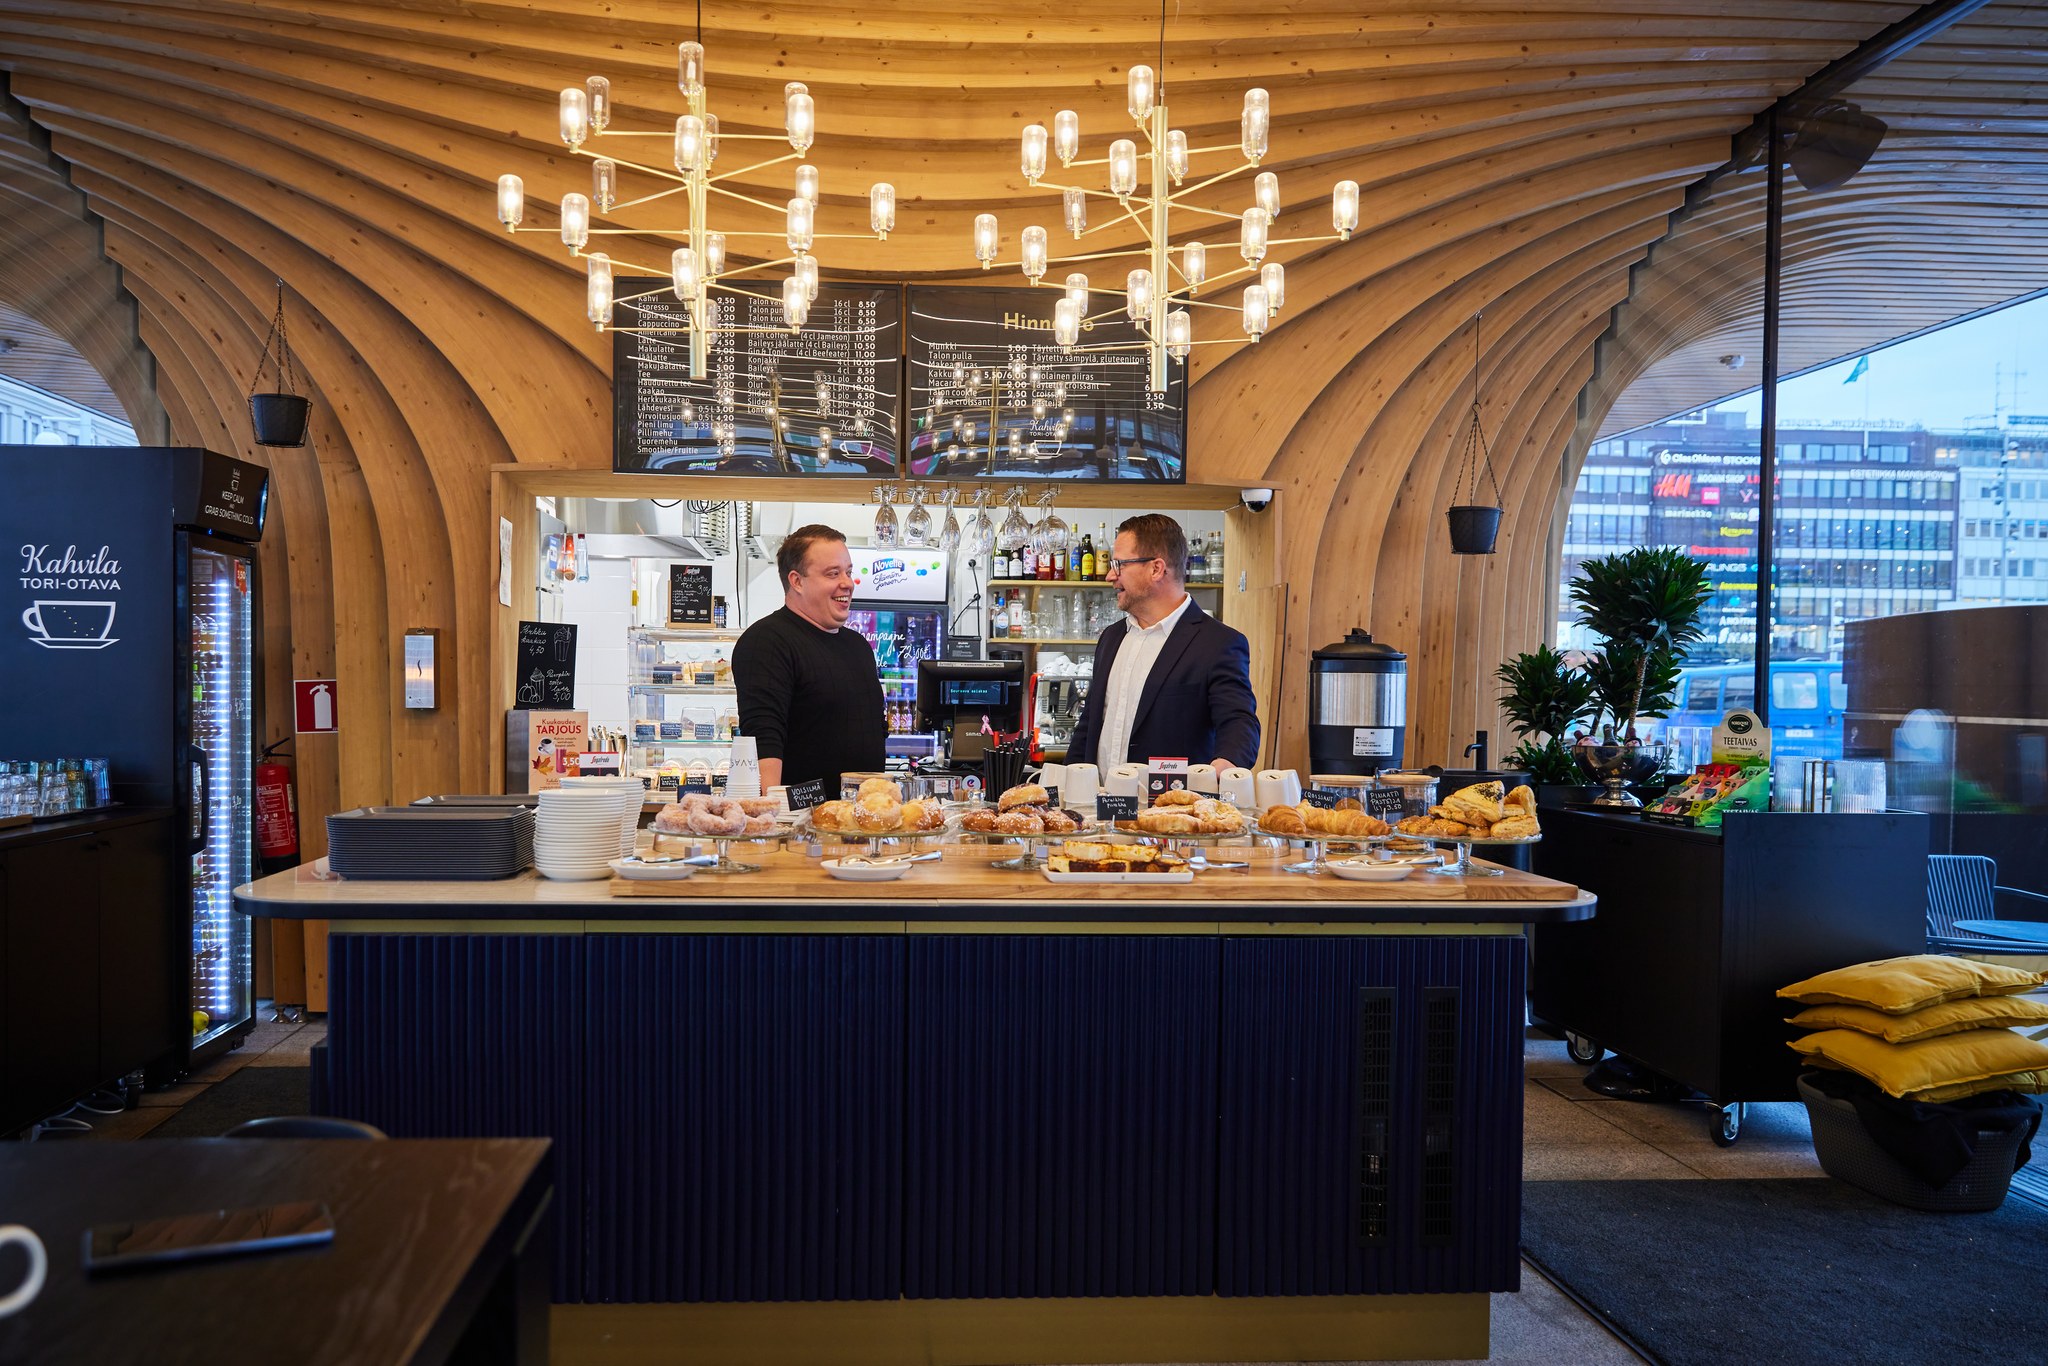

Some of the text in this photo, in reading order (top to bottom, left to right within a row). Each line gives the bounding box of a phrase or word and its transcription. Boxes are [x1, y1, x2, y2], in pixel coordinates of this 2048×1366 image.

[638, 303, 735, 314] Espresso 3,00
[858, 301, 876, 309] 8,50
[748, 306, 769, 314] Talon
[834, 308, 842, 316] 16
[858, 309, 876, 317] 8,50
[718, 314, 735, 322] 3,20
[748, 314, 769, 322] Talon
[858, 318, 876, 326] 6,50
[638, 320, 680, 329] Cappuccino
[766, 331, 789, 340] Coffee
[817, 333, 850, 341] Jameson)
[717, 339, 735, 347] 4,50
[748, 340, 875, 351] Baileys jäälatte Baileys) 10,50
[638, 345, 674, 353] Makulatte
[813, 349, 850, 358] Beefeater)
[855, 351, 875, 359] 11,00
[952, 352, 972, 360] pulla
[638, 353, 735, 364] Jäälatte 4,50
[748, 357, 780, 365] Konjakki
[1032, 353, 1145, 365] Täytetty sämpylä, gluteeniton
[716, 364, 735, 372] 5,00
[748, 365, 774, 373] Baileys
[716, 372, 735, 380] 2,50
[838, 375, 850, 383] plo
[857, 376, 875, 384] 8,00
[1072, 373, 1094, 381] piiras
[716, 381, 734, 389] 3,00
[838, 384, 850, 392] plo
[716, 389, 734, 398] 4,00
[838, 392, 850, 400] plo
[1007, 390, 1027, 398] 2,50
[1145, 393, 1164, 401] 2,50
[638, 396, 690, 404] Herkkukaakao
[838, 401, 850, 409] plo
[1032, 399, 1164, 410] Pasteija 3,50
[638, 404, 673, 412] Lähdevesi
[716, 406, 734, 414] 3,00
[838, 409, 850, 417] plo
[716, 414, 734, 422] 4,20
[694, 422, 709, 430] 0,33
[716, 439, 734, 447] 3,50
[638, 446, 699, 454] Smoothie/Fruitie
[1654, 474, 1692, 498] H&M
[205, 505, 219, 516] GRAB
[242, 515, 254, 524] COLD
[21, 544, 122, 574] Kahvila
[874, 558, 904, 573] Novelle
[20, 578, 121, 590] TORI-OTAVA
[529, 645, 544, 656] 4,50
[553, 692, 571, 702] 5,00
[536, 726, 581, 735] TARJOUS
[1724, 737, 1758, 746] TEETAIVAS
[562, 757, 580, 767] 3,50
[1159, 762, 1178, 770] Segafredo
[791, 782, 821, 796] VOISILMÄ
[793, 794, 813, 802] PULLA
